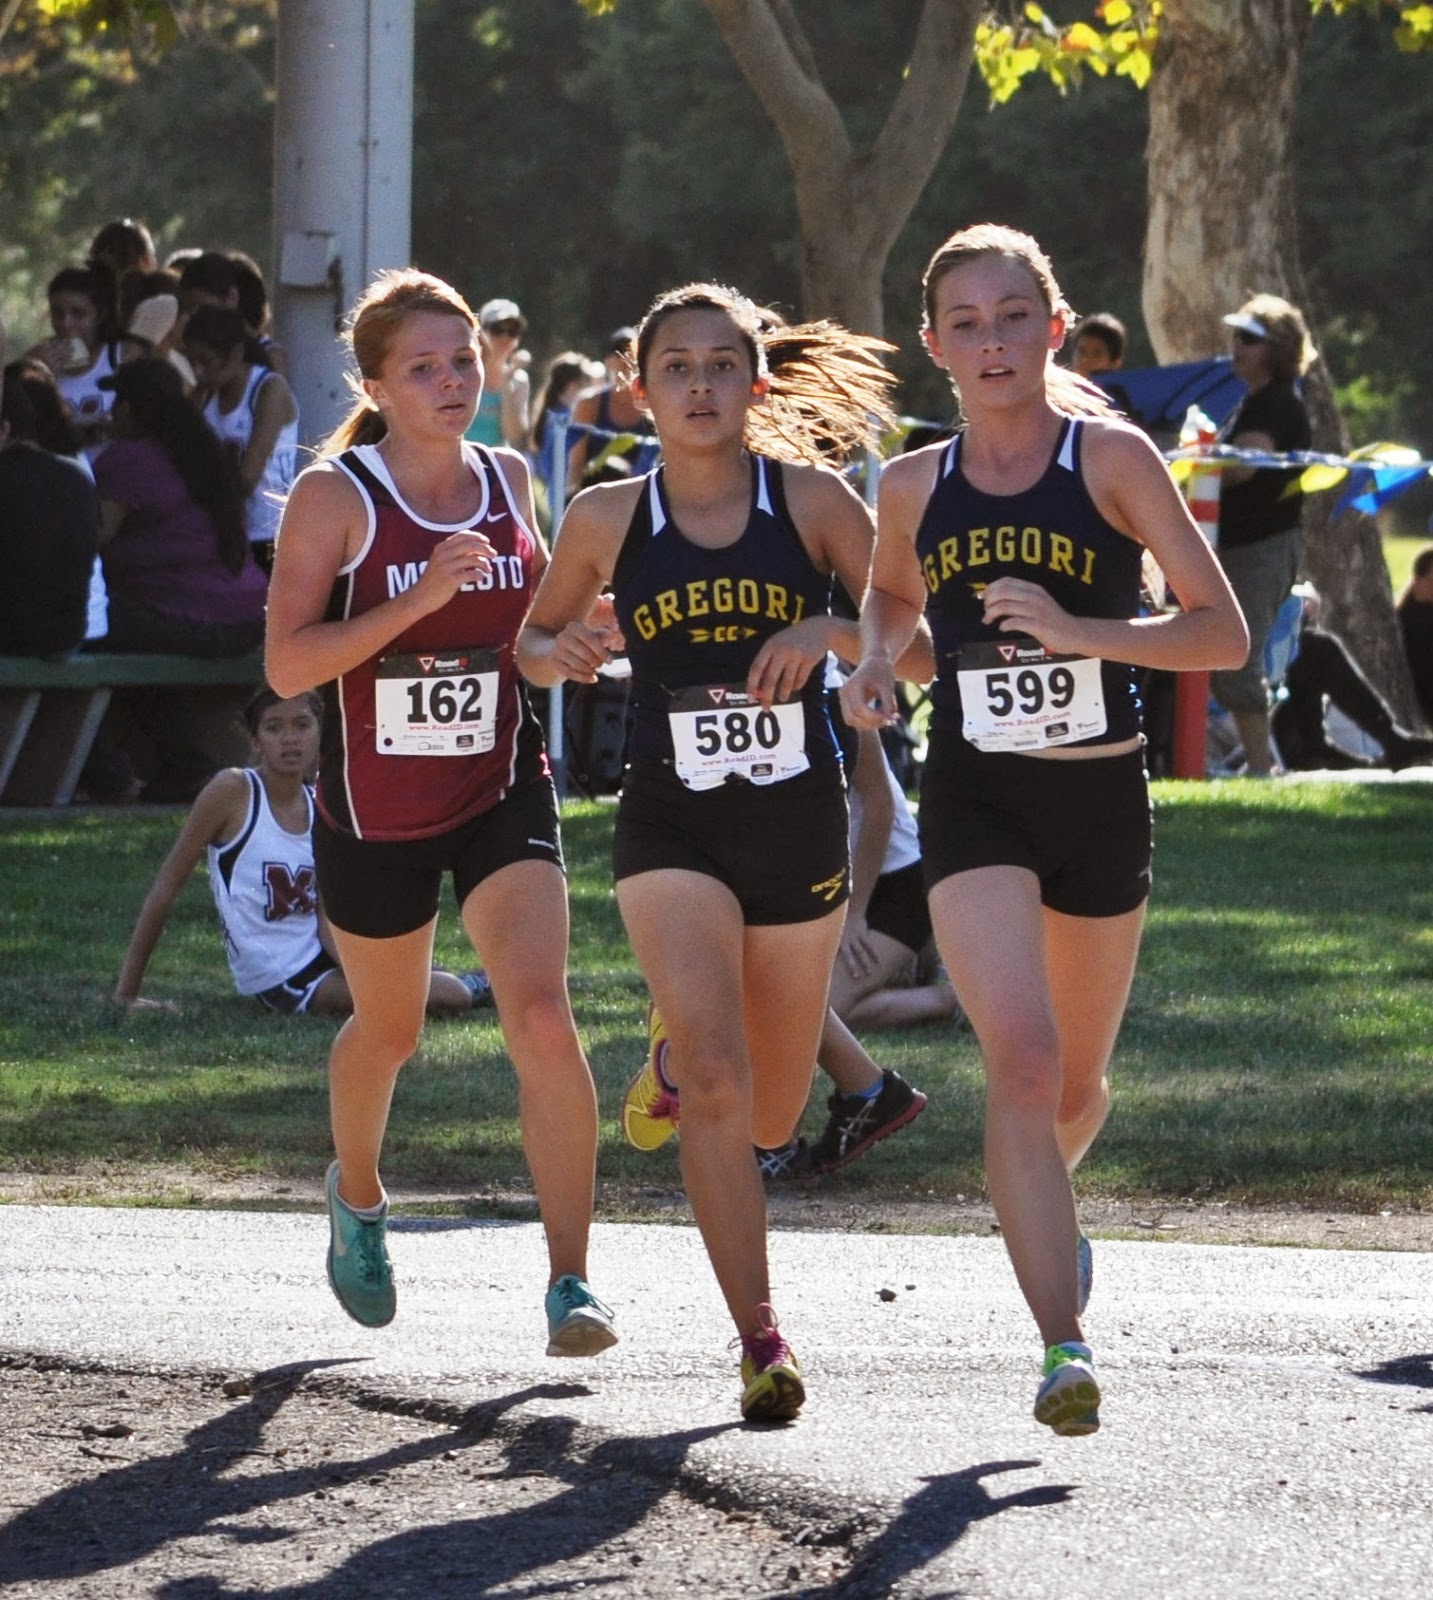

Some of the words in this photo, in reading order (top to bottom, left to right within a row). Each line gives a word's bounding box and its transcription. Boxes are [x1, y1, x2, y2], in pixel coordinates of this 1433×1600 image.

[922, 525, 1096, 594] GREGORI
[633, 578, 806, 641] GREGORI
[714, 625, 739, 643] CC
[407, 677, 482, 724] 162
[985, 666, 1075, 717] 599
[695, 709, 781, 756] 580
[262, 861, 316, 922] M
